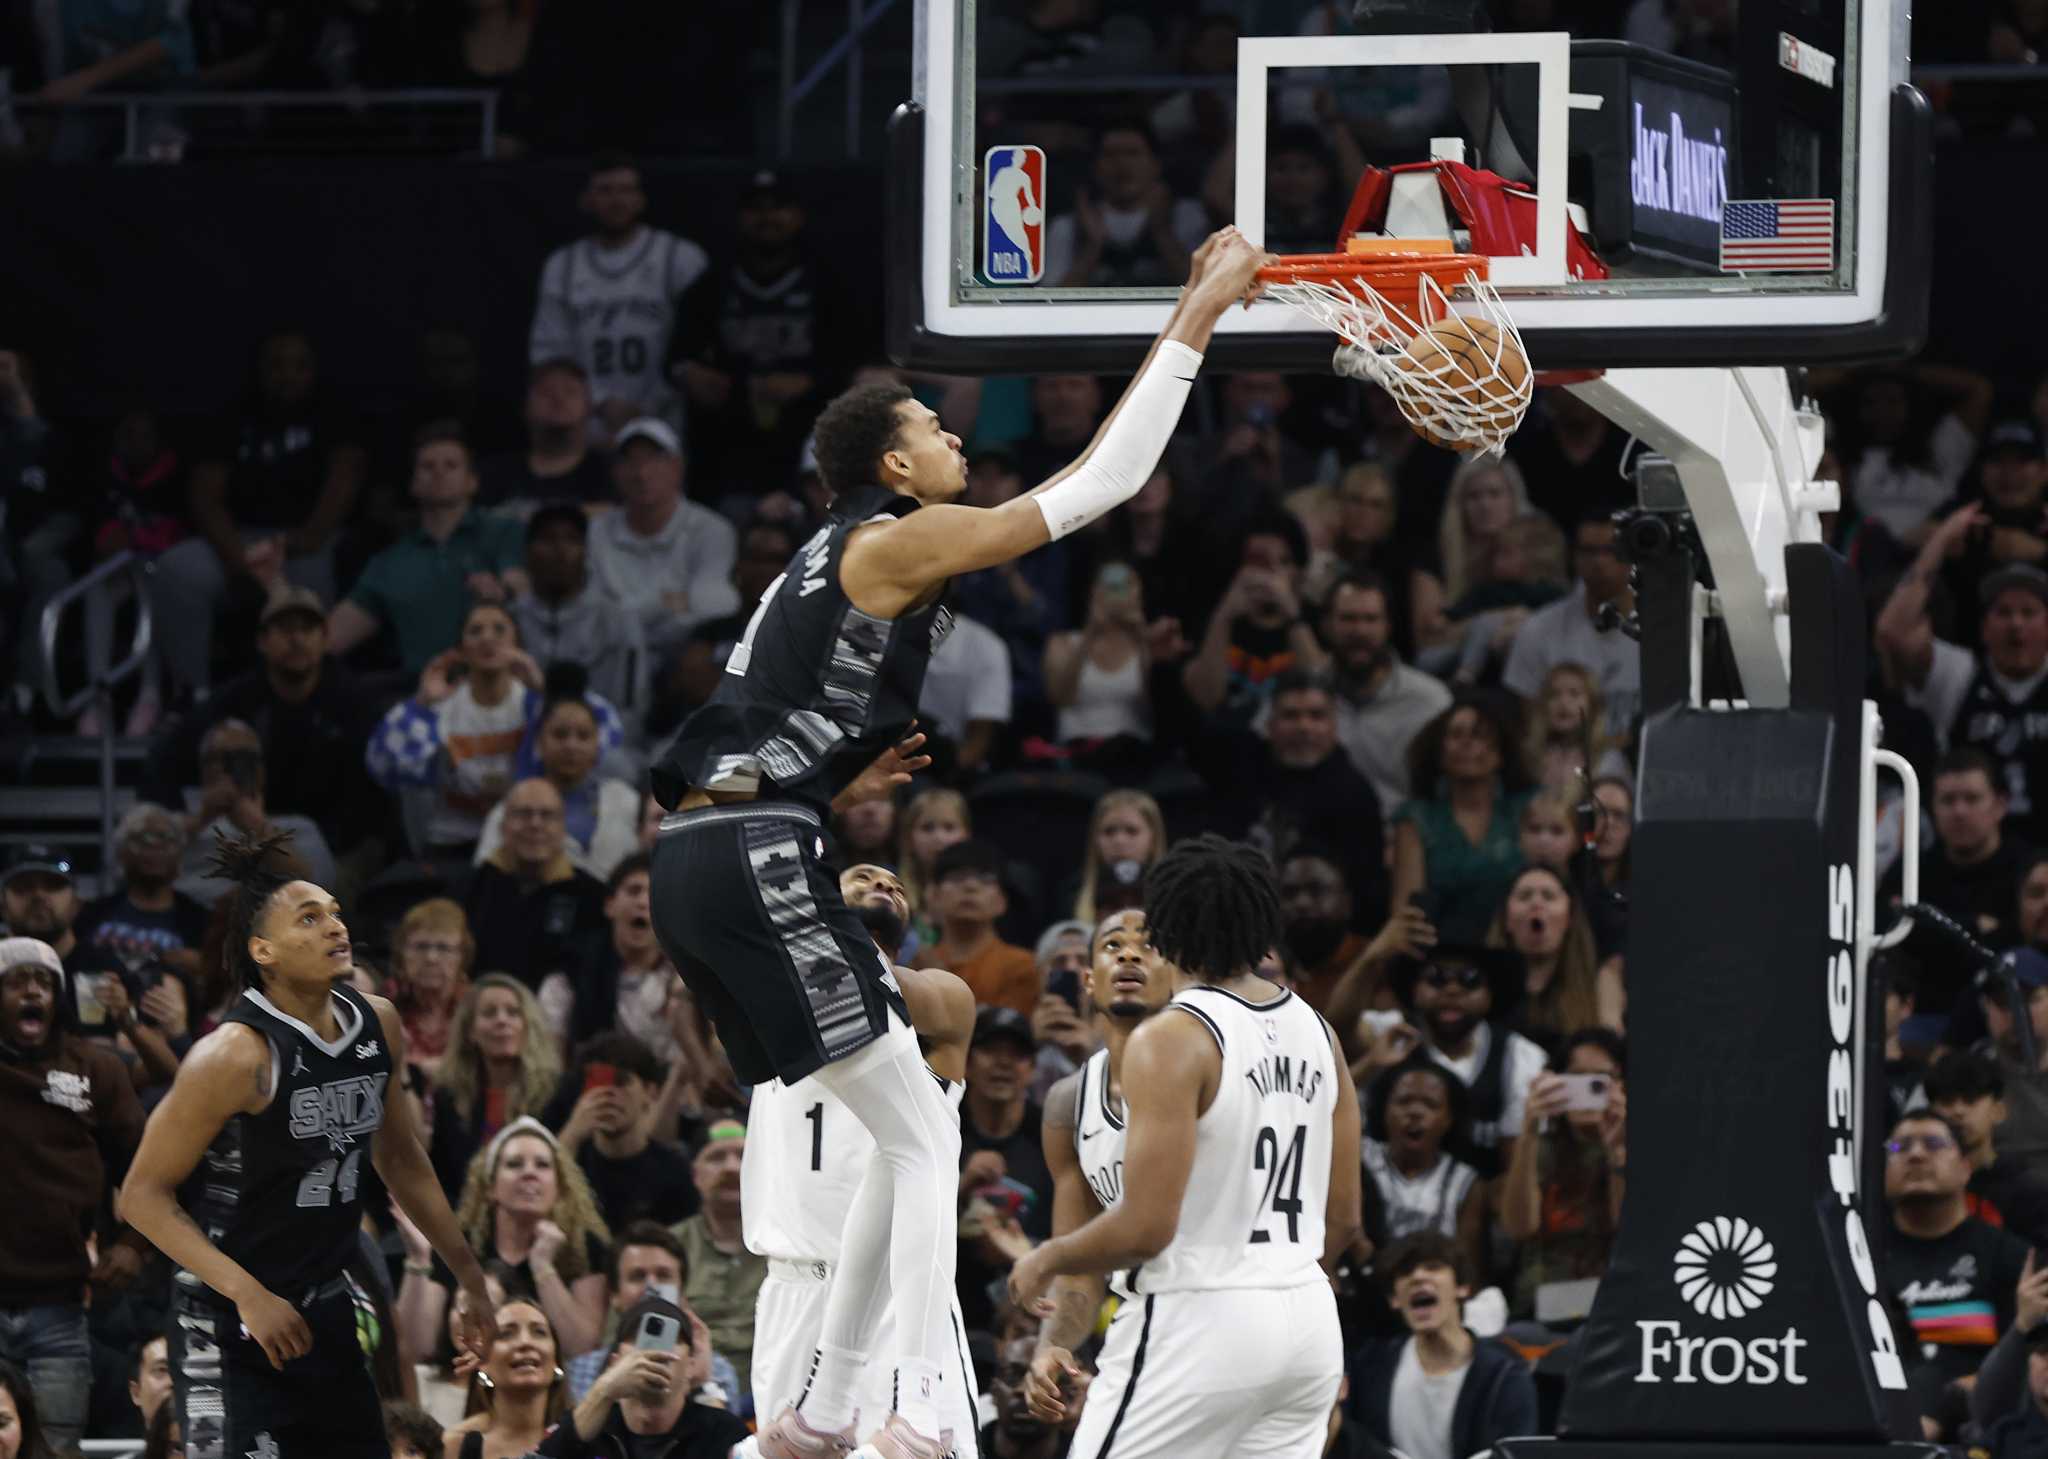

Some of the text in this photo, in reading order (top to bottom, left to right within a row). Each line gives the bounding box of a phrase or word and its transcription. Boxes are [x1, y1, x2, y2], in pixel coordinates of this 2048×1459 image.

[993, 252, 1022, 274] NBA
[594, 336, 647, 375] 20
[289, 1072, 389, 1140] SATX
[806, 1103, 823, 1171] 1
[1827, 862, 1908, 1390] bet365
[1249, 1125, 1307, 1243] 24
[1633, 1319, 1809, 1385] Frost
